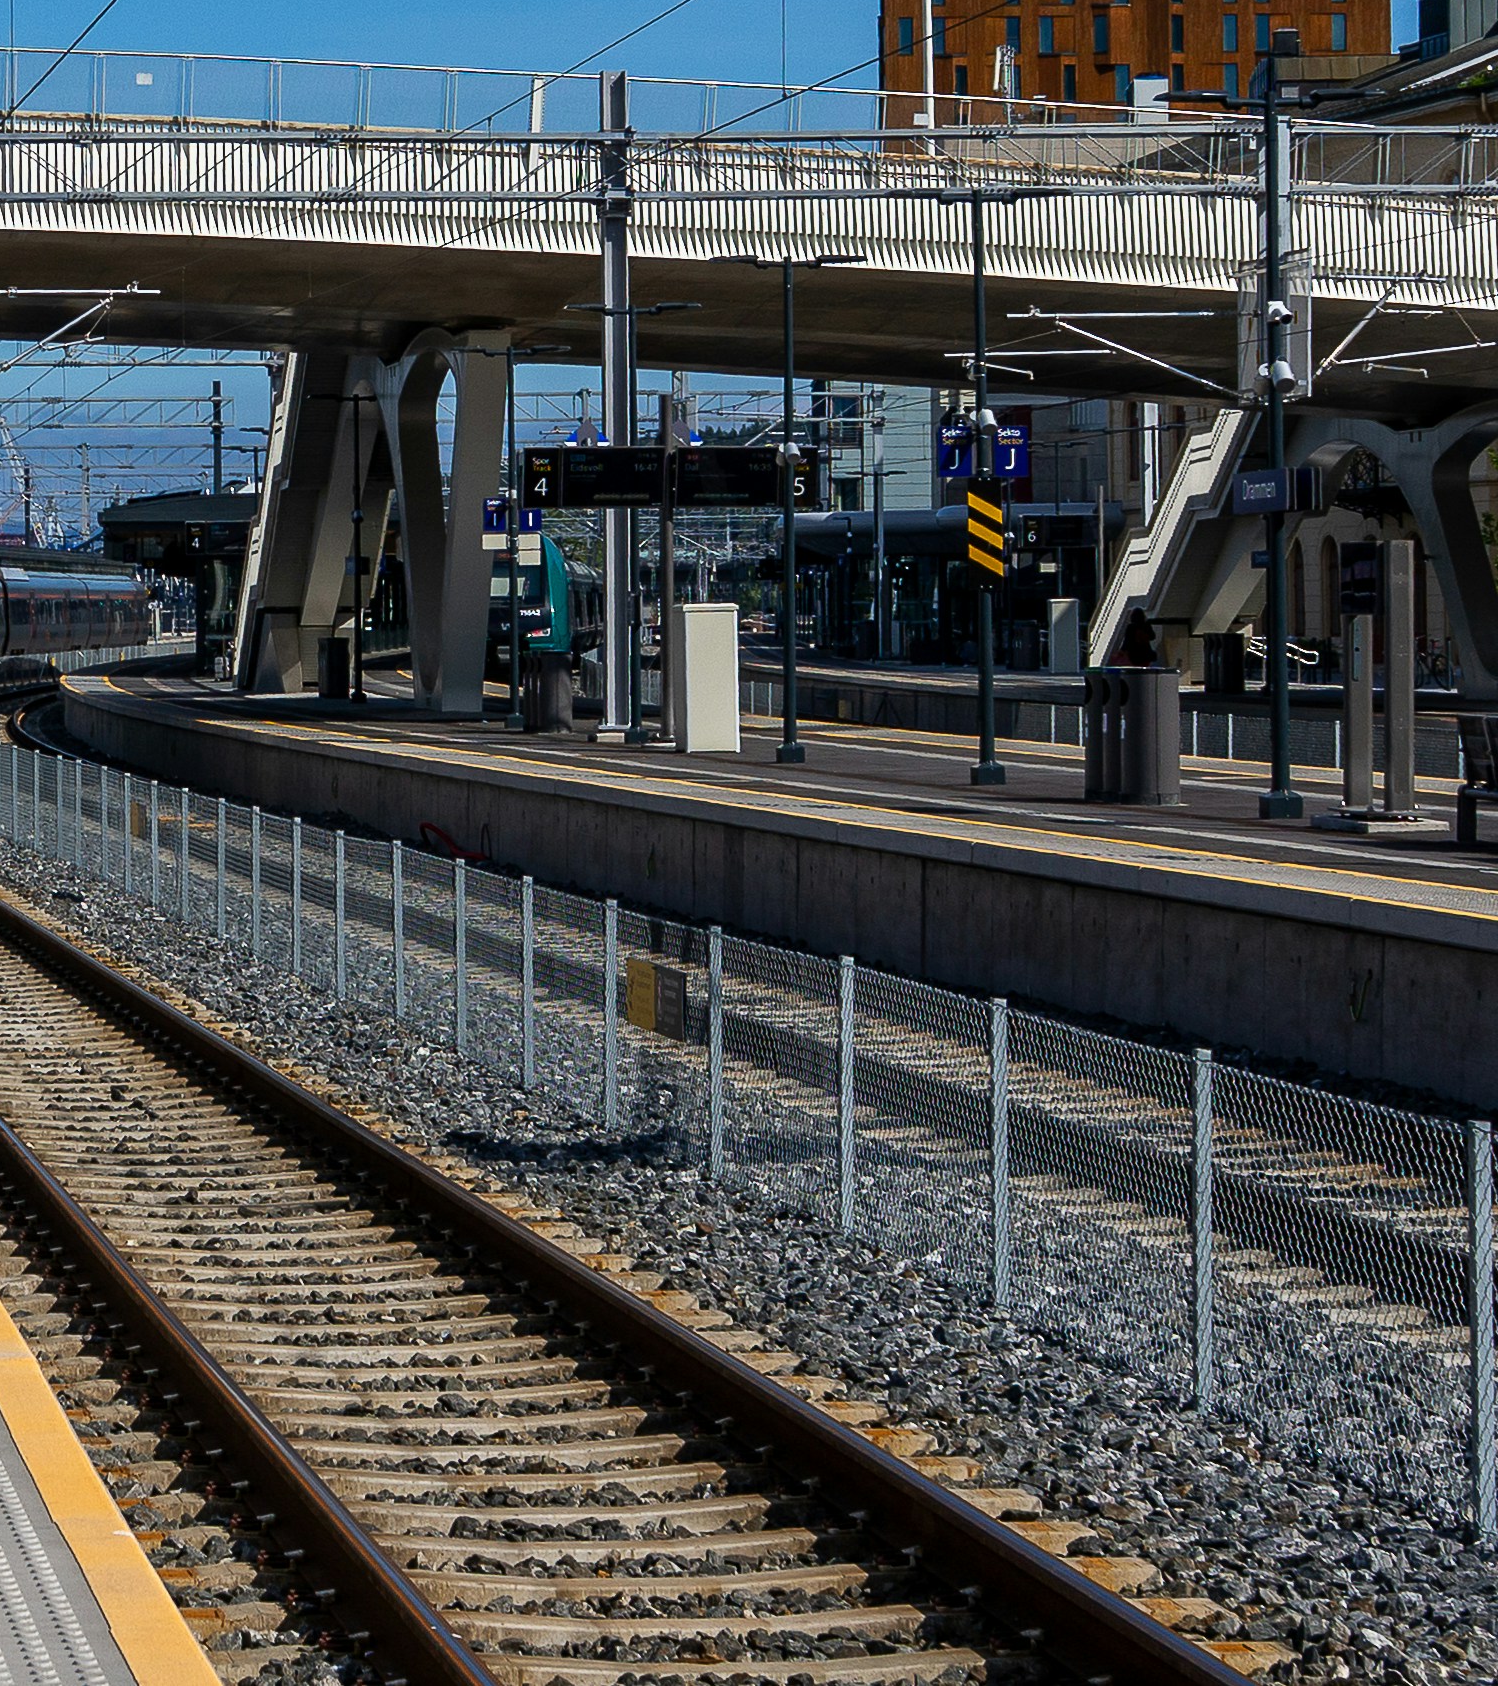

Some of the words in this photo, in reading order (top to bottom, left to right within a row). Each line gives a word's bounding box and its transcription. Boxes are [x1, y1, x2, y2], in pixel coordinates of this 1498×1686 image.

[948, 448, 959, 470] J
[1004, 447, 1015, 470] J
[534, 477, 549, 497] 4
[792, 477, 806, 496] 5
[191, 537, 200, 549] 4
[1027, 531, 1037, 542] 6
